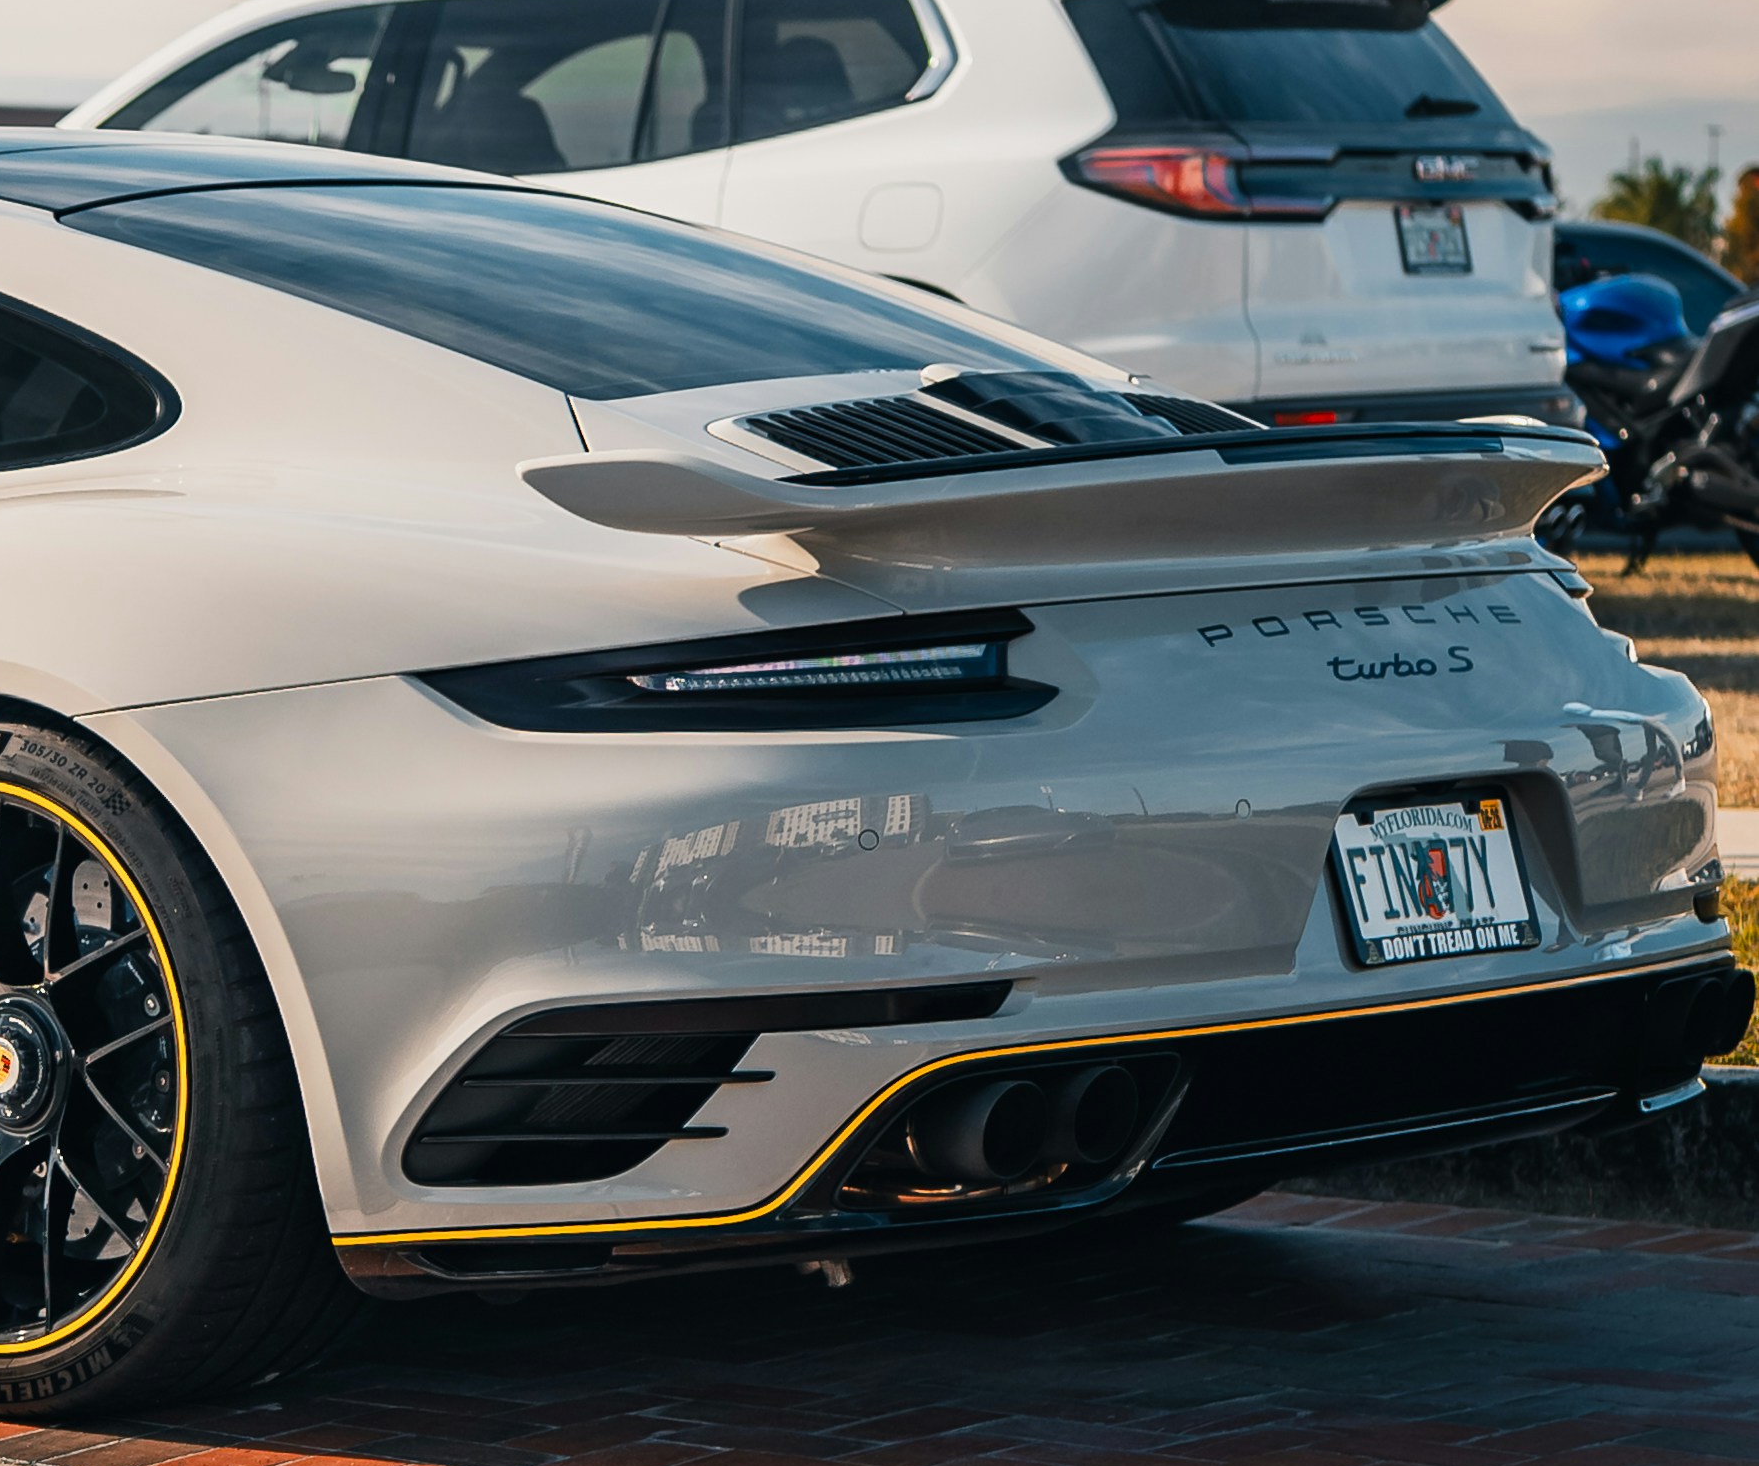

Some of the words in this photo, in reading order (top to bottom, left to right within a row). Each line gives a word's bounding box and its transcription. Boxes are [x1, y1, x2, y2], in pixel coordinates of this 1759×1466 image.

[1197, 605, 1522, 648] PORSCHE
[1327, 653, 1438, 682] turbo
[1448, 646, 1474, 673] S
[20, 739, 68, 768] 305/30
[68, 762, 88, 781] ZR
[87, 776, 106, 794] 20
[1369, 807, 1473, 842] MYFLORIDA.COM
[1382, 934, 1425, 961] DON'T
[1427, 929, 1474, 955] TREAD
[1475, 927, 1497, 949] ON
[1498, 923, 1520, 946] ME
